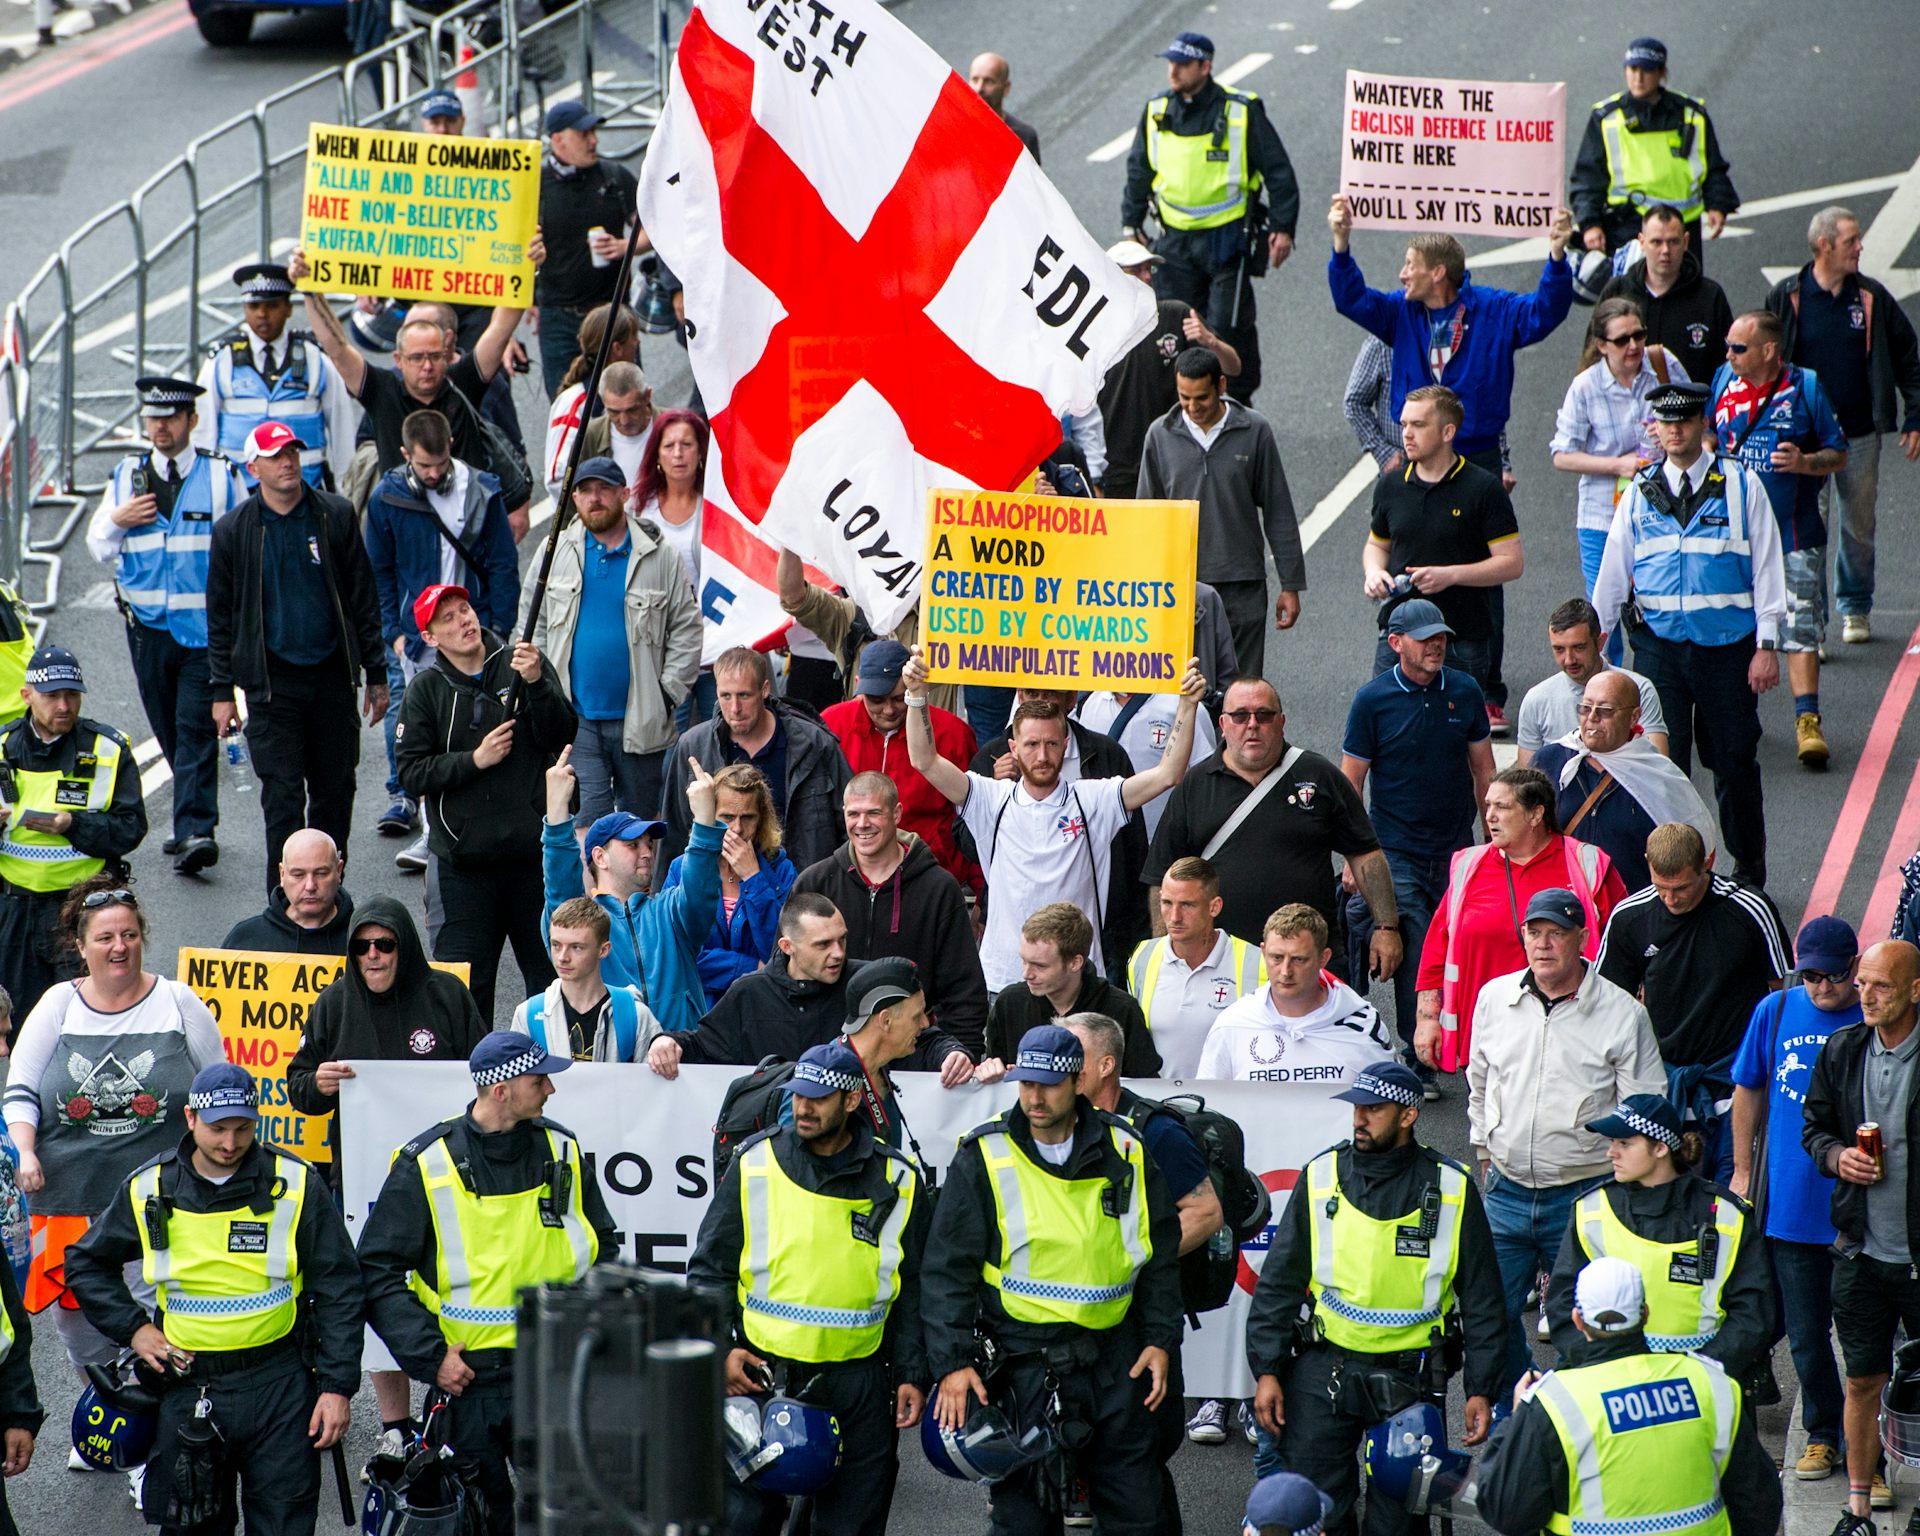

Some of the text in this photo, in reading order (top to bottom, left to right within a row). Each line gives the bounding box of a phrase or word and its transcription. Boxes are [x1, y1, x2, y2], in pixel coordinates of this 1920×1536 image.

[1353, 80, 1494, 112] WHATEVER THE
[1351, 110, 1554, 142] ENGLISH DEFENCE LEAGUE
[316, 133, 531, 171] WHEN ALLAH COMMANDS:
[1351, 138, 1456, 166] WRITE HERE
[380, 171, 413, 195] AND
[423, 174, 512, 201] BELIEVERS
[308, 194, 498, 231] HATE NON-BELIEVERS
[1348, 195, 1553, 227] YOU'LL SAY IT'S RACIST
[313, 260, 331, 283] IS
[339, 262, 382, 287] THAT
[392, 266, 433, 291] HATE
[443, 270, 505, 297] SPEECH
[934, 497, 1108, 536] ISLAMOPHOBIA
[932, 534, 1045, 567] A WORD
[931, 570, 1176, 608] CREATED BY FASCISTS
[929, 606, 1149, 643] USED BY COWARDS
[927, 642, 1175, 680] TO MANIPULATE MORONS
[188, 958, 269, 991] NEVER
[1782, 1034, 1829, 1051] FUCK
[1249, 1066, 1344, 1082] FRED PERRY
[871, 1103, 884, 1125] EOS
[1607, 1384, 1695, 1426] POLICE
[87, 1435, 112, 1452] MP
